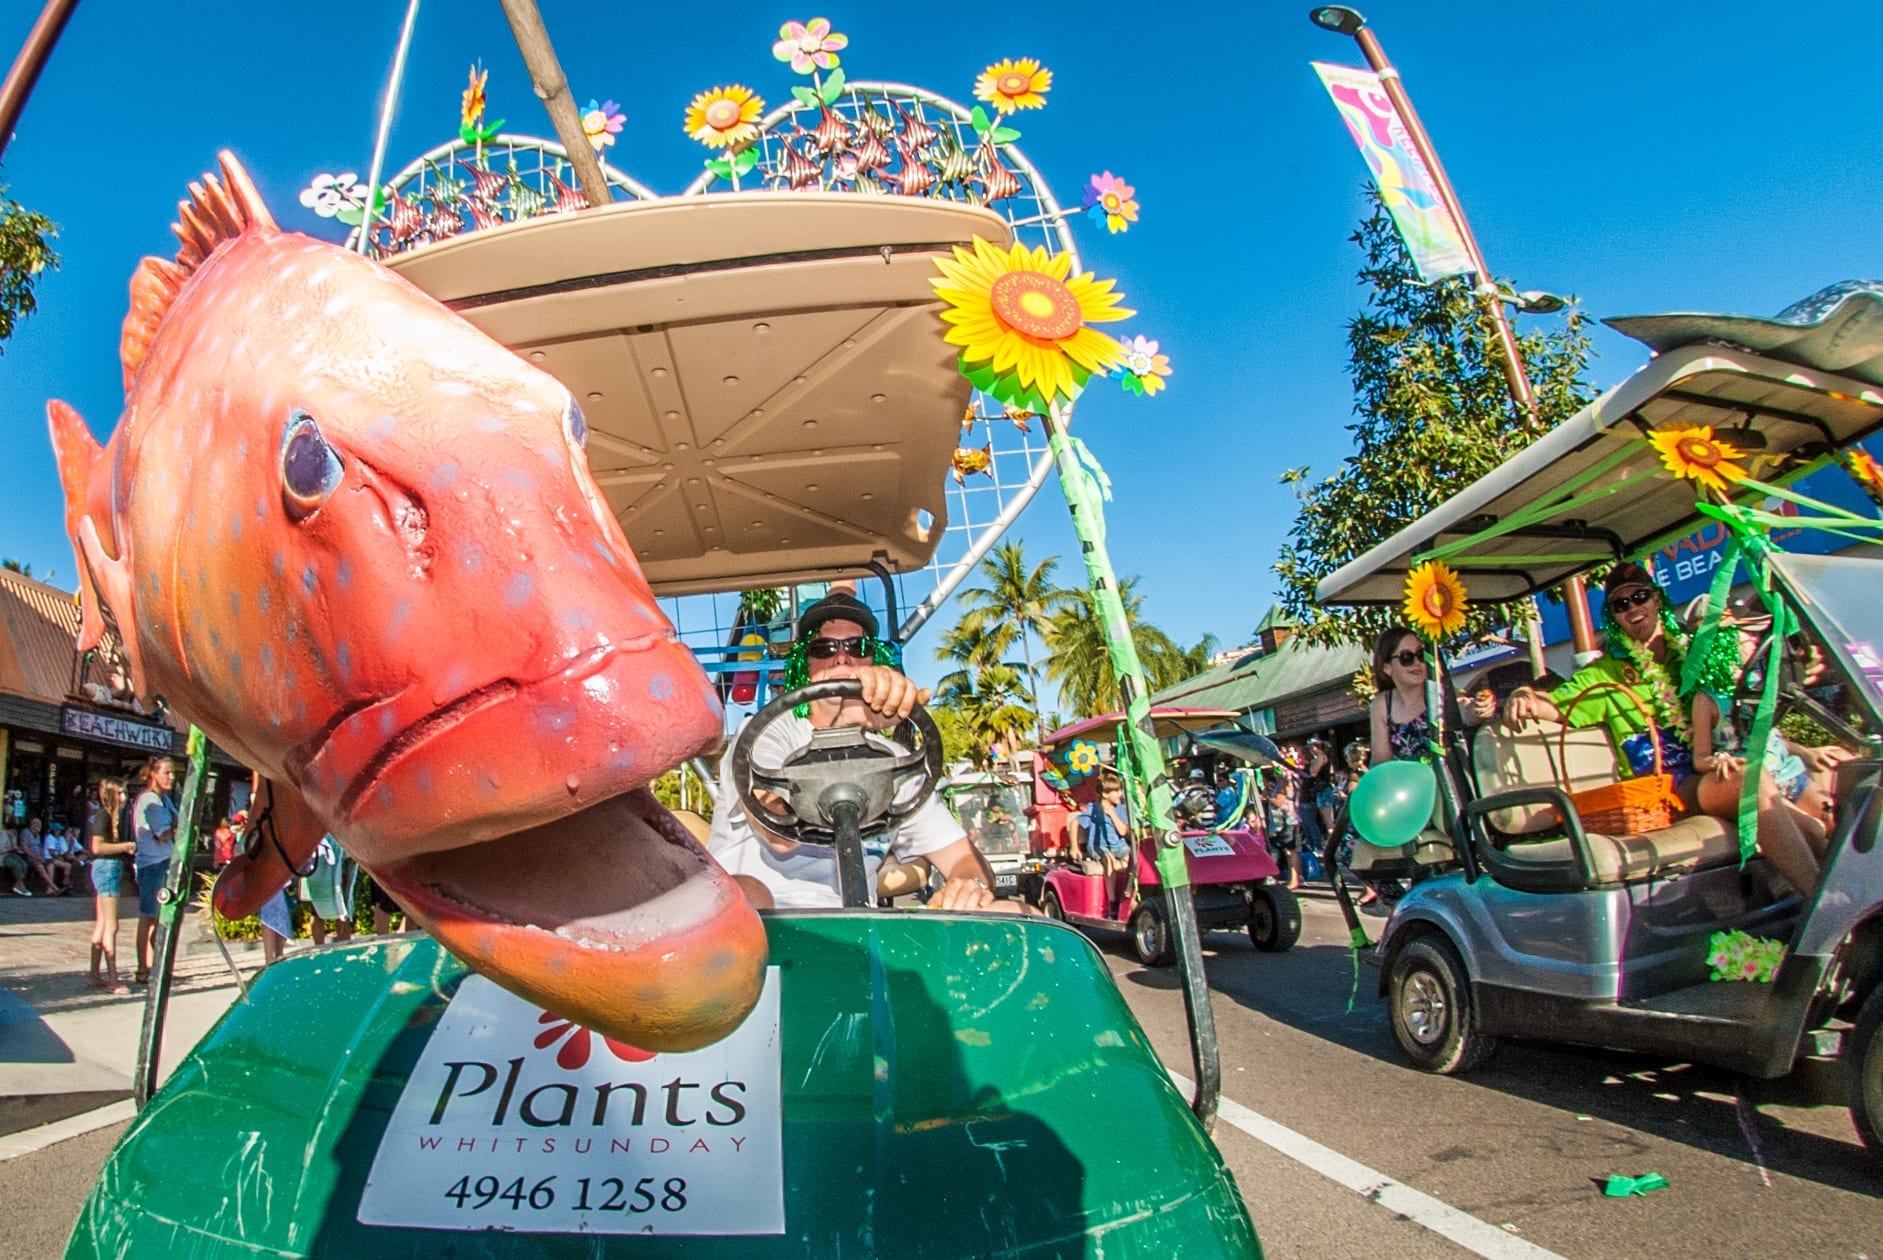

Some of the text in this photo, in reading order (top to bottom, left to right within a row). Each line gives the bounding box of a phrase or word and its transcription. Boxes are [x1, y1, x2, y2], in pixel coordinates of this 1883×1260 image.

[1675, 550, 1742, 581] BEA
[429, 1057, 746, 1127] Plants
[419, 1136, 748, 1154] WHITSUNDAY
[445, 1174, 688, 1213] 4946 1258
